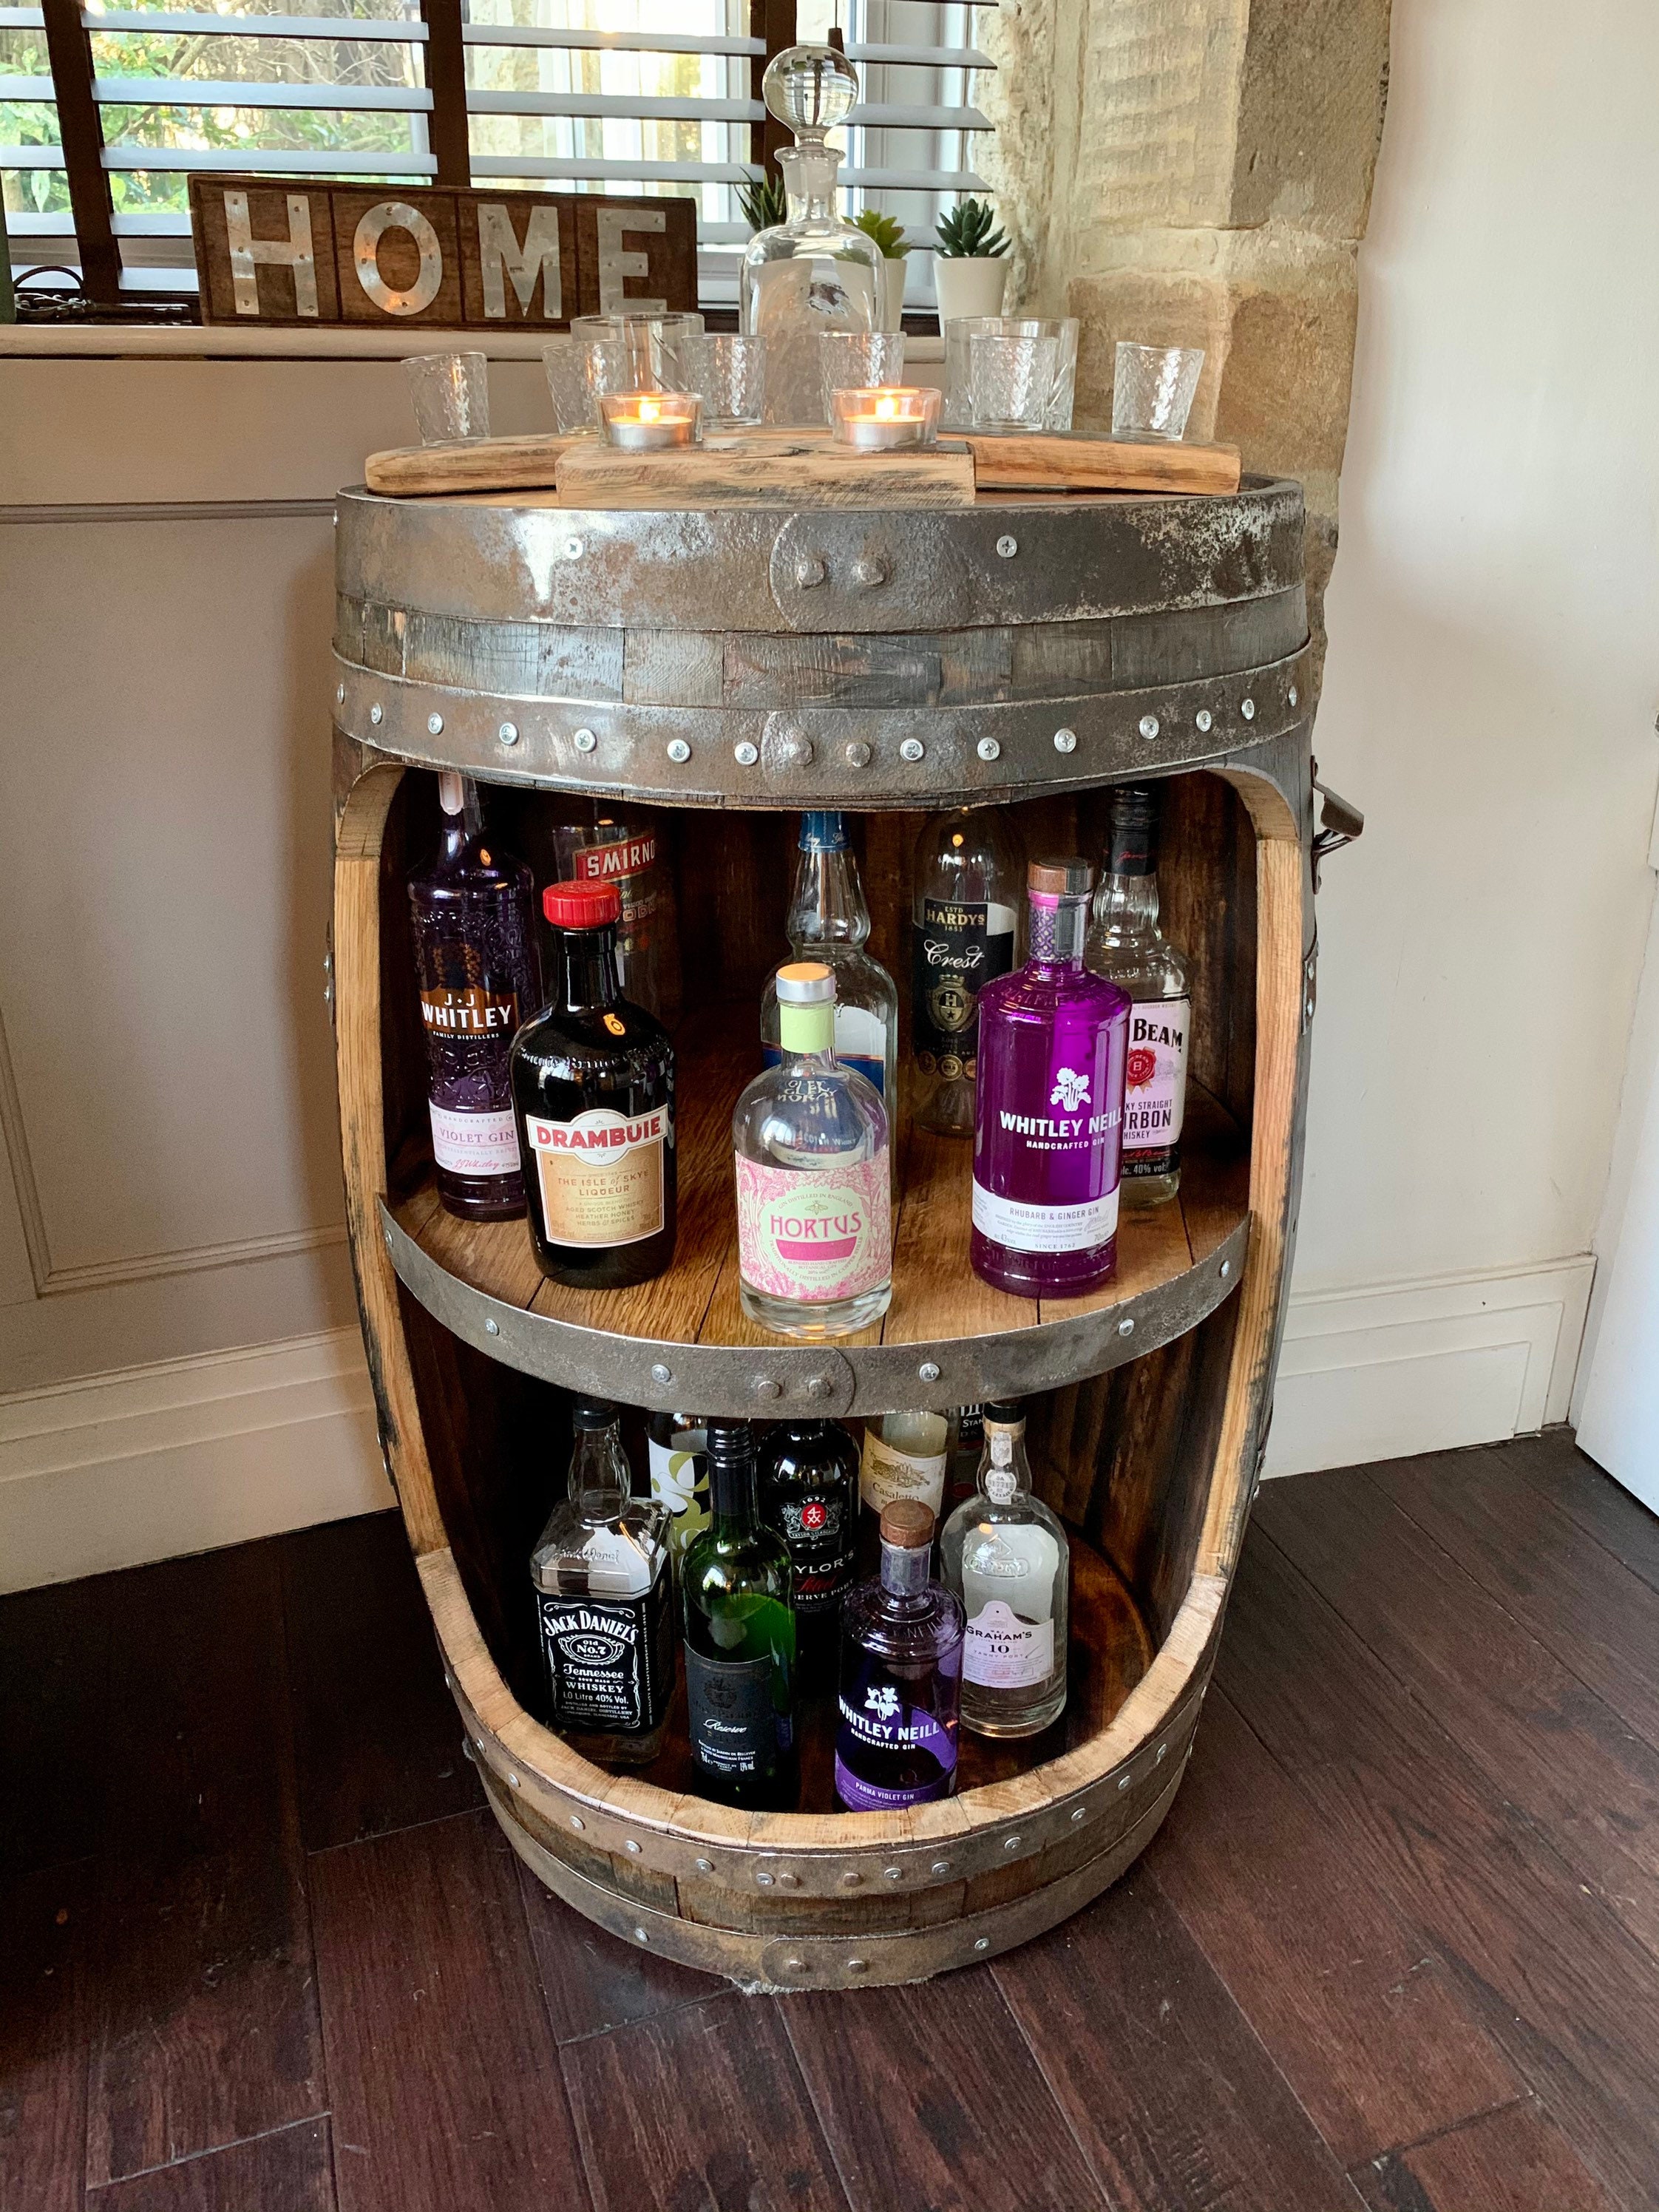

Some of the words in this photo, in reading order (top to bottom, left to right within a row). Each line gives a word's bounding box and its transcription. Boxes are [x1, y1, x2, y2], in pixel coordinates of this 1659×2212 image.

[223, 190, 668, 319] HOME
[926, 909, 985, 926] HARDYS
[923, 939, 985, 968] Crest
[421, 1001, 512, 1028] WHITLEY
[432, 1031, 454, 1039] FAMILY
[1132, 1018, 1184, 1049] BEAM
[1138, 1099, 1173, 1110] STRAIGHT
[1000, 1110, 1084, 1137] WHITLEY
[1088, 1106, 1122, 1134] NEILL
[439, 1127, 483, 1143] VIOLET
[488, 1130, 515, 1142] GIN
[536, 1116, 661, 1149] DRAMBUIE
[1124, 1130, 1150, 1139] HISKEY
[1026, 1140, 1089, 1150] HANDCRAFTED
[1092, 1137, 1105, 1146] GIN
[1133, 1164, 1151, 1174] 40%
[558, 1178, 577, 1186] THE
[582, 1178, 606, 1187] ISLE
[623, 1170, 649, 1182] SKYE
[579, 1185, 630, 1196] LIQUEUR
[618, 1200, 644, 1210] WHISKY
[788, 1193, 818, 1203] DISTILLED
[828, 1194, 852, 1207] ENGLAND
[611, 1210, 635, 1218] HONEY
[611, 1215, 635, 1224] SPICES
[1009, 1207, 1046, 1220] RHUBARB
[1057, 1209, 1085, 1220] GINGER
[1088, 1207, 1099, 1216] GIN
[770, 1211, 863, 1238] HORTUS
[794, 1550, 854, 1574] YLOR'S
[543, 1615, 580, 1636] JACK
[579, 1610, 639, 1645] DANIEL'S
[966, 1626, 1032, 1641] GRAHAM'S
[577, 1644, 606, 1655] No.7
[989, 1644, 1009, 1654] 10
[563, 1663, 624, 1678] Tennessee
[566, 1681, 624, 1694] WHISKEY
[574, 1692, 593, 1700] Litre
[595, 1694, 613, 1703] 40%
[614, 1695, 629, 1704] Vol.
[838, 1694, 893, 1740] WHITLEY
[898, 1722, 940, 1741] NEILL
[851, 1728, 899, 1750] HANDCRAFTED
[855, 1782, 876, 1796] PARMA
[878, 1791, 900, 1801] VIOLET
